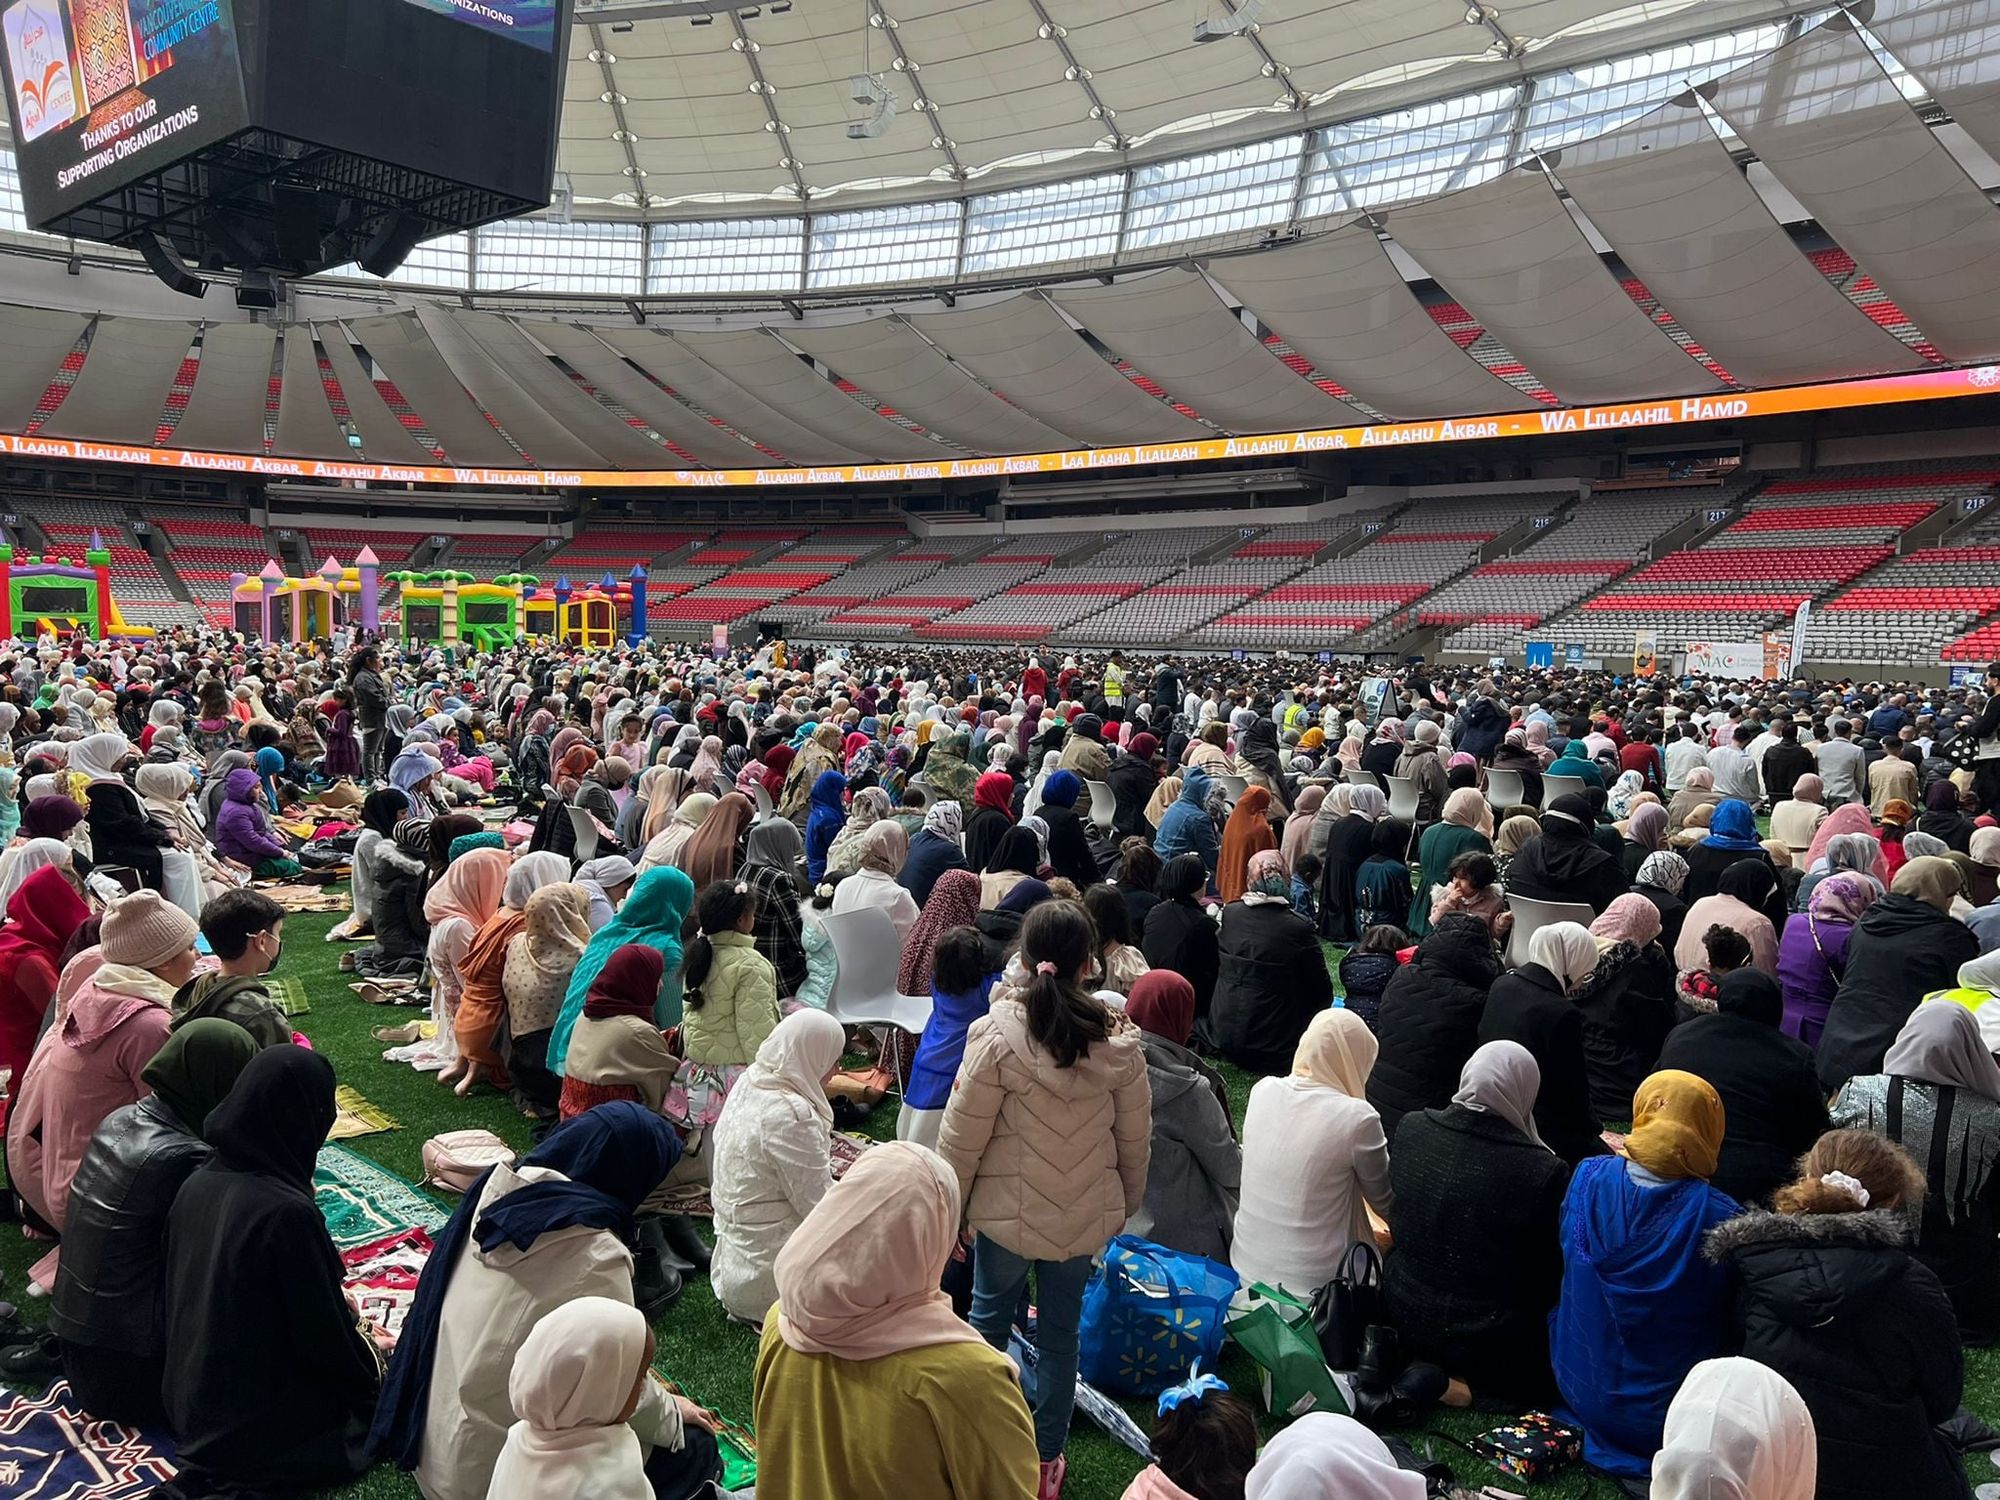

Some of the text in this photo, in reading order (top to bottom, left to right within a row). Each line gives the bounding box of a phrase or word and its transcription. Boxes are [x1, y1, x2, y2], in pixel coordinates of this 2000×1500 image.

[143, 0, 219, 60] COMMUNITY CENTRE
[57, 105, 199, 188] SUPPORTING ORGANIZATIONS
[80, 99, 158, 151] THANKS TO OUR
[11, 437, 69, 456] ILAAHA
[74, 442, 150, 463] ILLALLAAH
[180, 451, 246, 470] ALLAAHU
[314, 462, 376, 479] ALLAAHU
[381, 466, 425, 481] AKBAR
[454, 469, 478, 483] WA
[483, 469, 540, 485] LILLAAHIL
[544, 469, 582, 485] HAMD
[755, 470, 803, 484] ALLAAHU
[853, 466, 899, 481] ALLAAHU
[950, 461, 999, 476] ALLAAHU
[1003, 457, 1040, 472] AKBAR
[1061, 453, 1083, 468] LAA
[1088, 450, 1130, 466] ILAAHA
[1135, 446, 1198, 463] ILLALLAAH
[1224, 438, 1288, 456] ALLAAHU
[1360, 427, 1434, 446] ALLAAHU
[1439, 420, 1497, 439] AKBAR
[1540, 411, 1576, 431] WA
[1584, 408, 1673, 429] LILLAAHIL
[1681, 398, 1748, 420] HAMD
[1709, 511, 1726, 521] 217
[1966, 498, 1985, 510] 218
[1697, 654, 1734, 668] MAC
